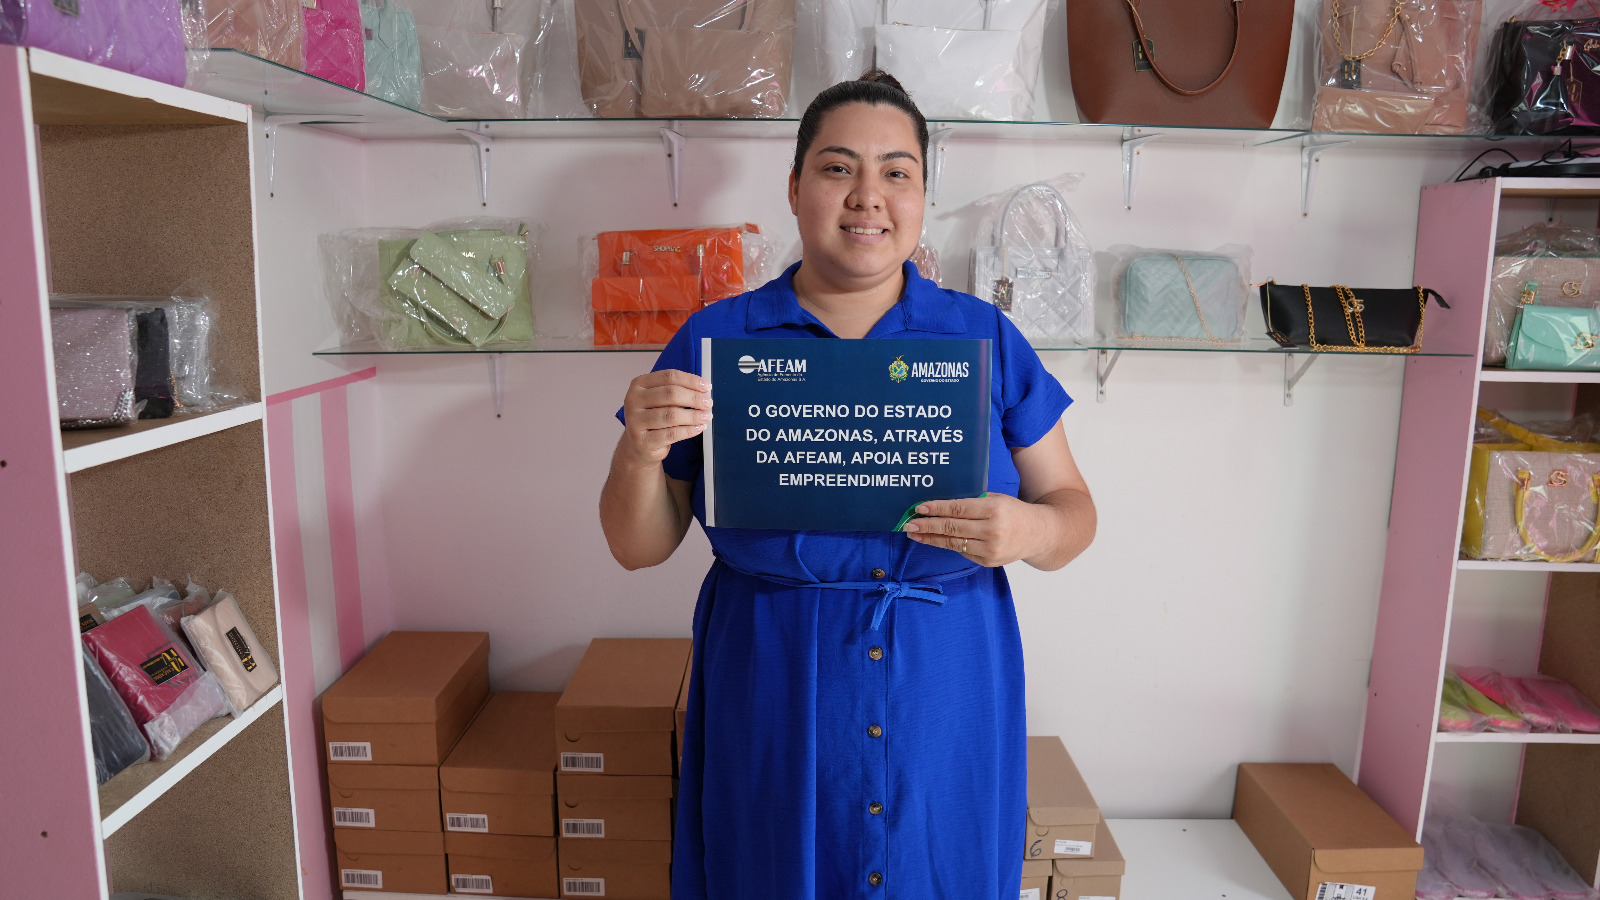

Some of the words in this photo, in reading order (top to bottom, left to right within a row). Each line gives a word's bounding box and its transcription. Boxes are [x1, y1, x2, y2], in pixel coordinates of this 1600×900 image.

[757, 358, 807, 373] AFEAM
[911, 361, 970, 378] AMAZONAS
[748, 404, 761, 418] O
[765, 404, 850, 418] GOVERNO
[854, 404, 879, 418] DO
[883, 404, 952, 419] ESTADO
[746, 428, 771, 442] DO
[775, 428, 878, 445] AMAZONAS,
[882, 425, 964, 443] ATRAVÉS
[756, 450, 780, 464] DA
[783, 451, 846, 467] AFEAM,
[850, 451, 904, 465] APOIA
[907, 451, 950, 465] ESTE
[779, 473, 934, 488] EMPREENDIMENTO
[1355, 887, 1368, 896] 41
